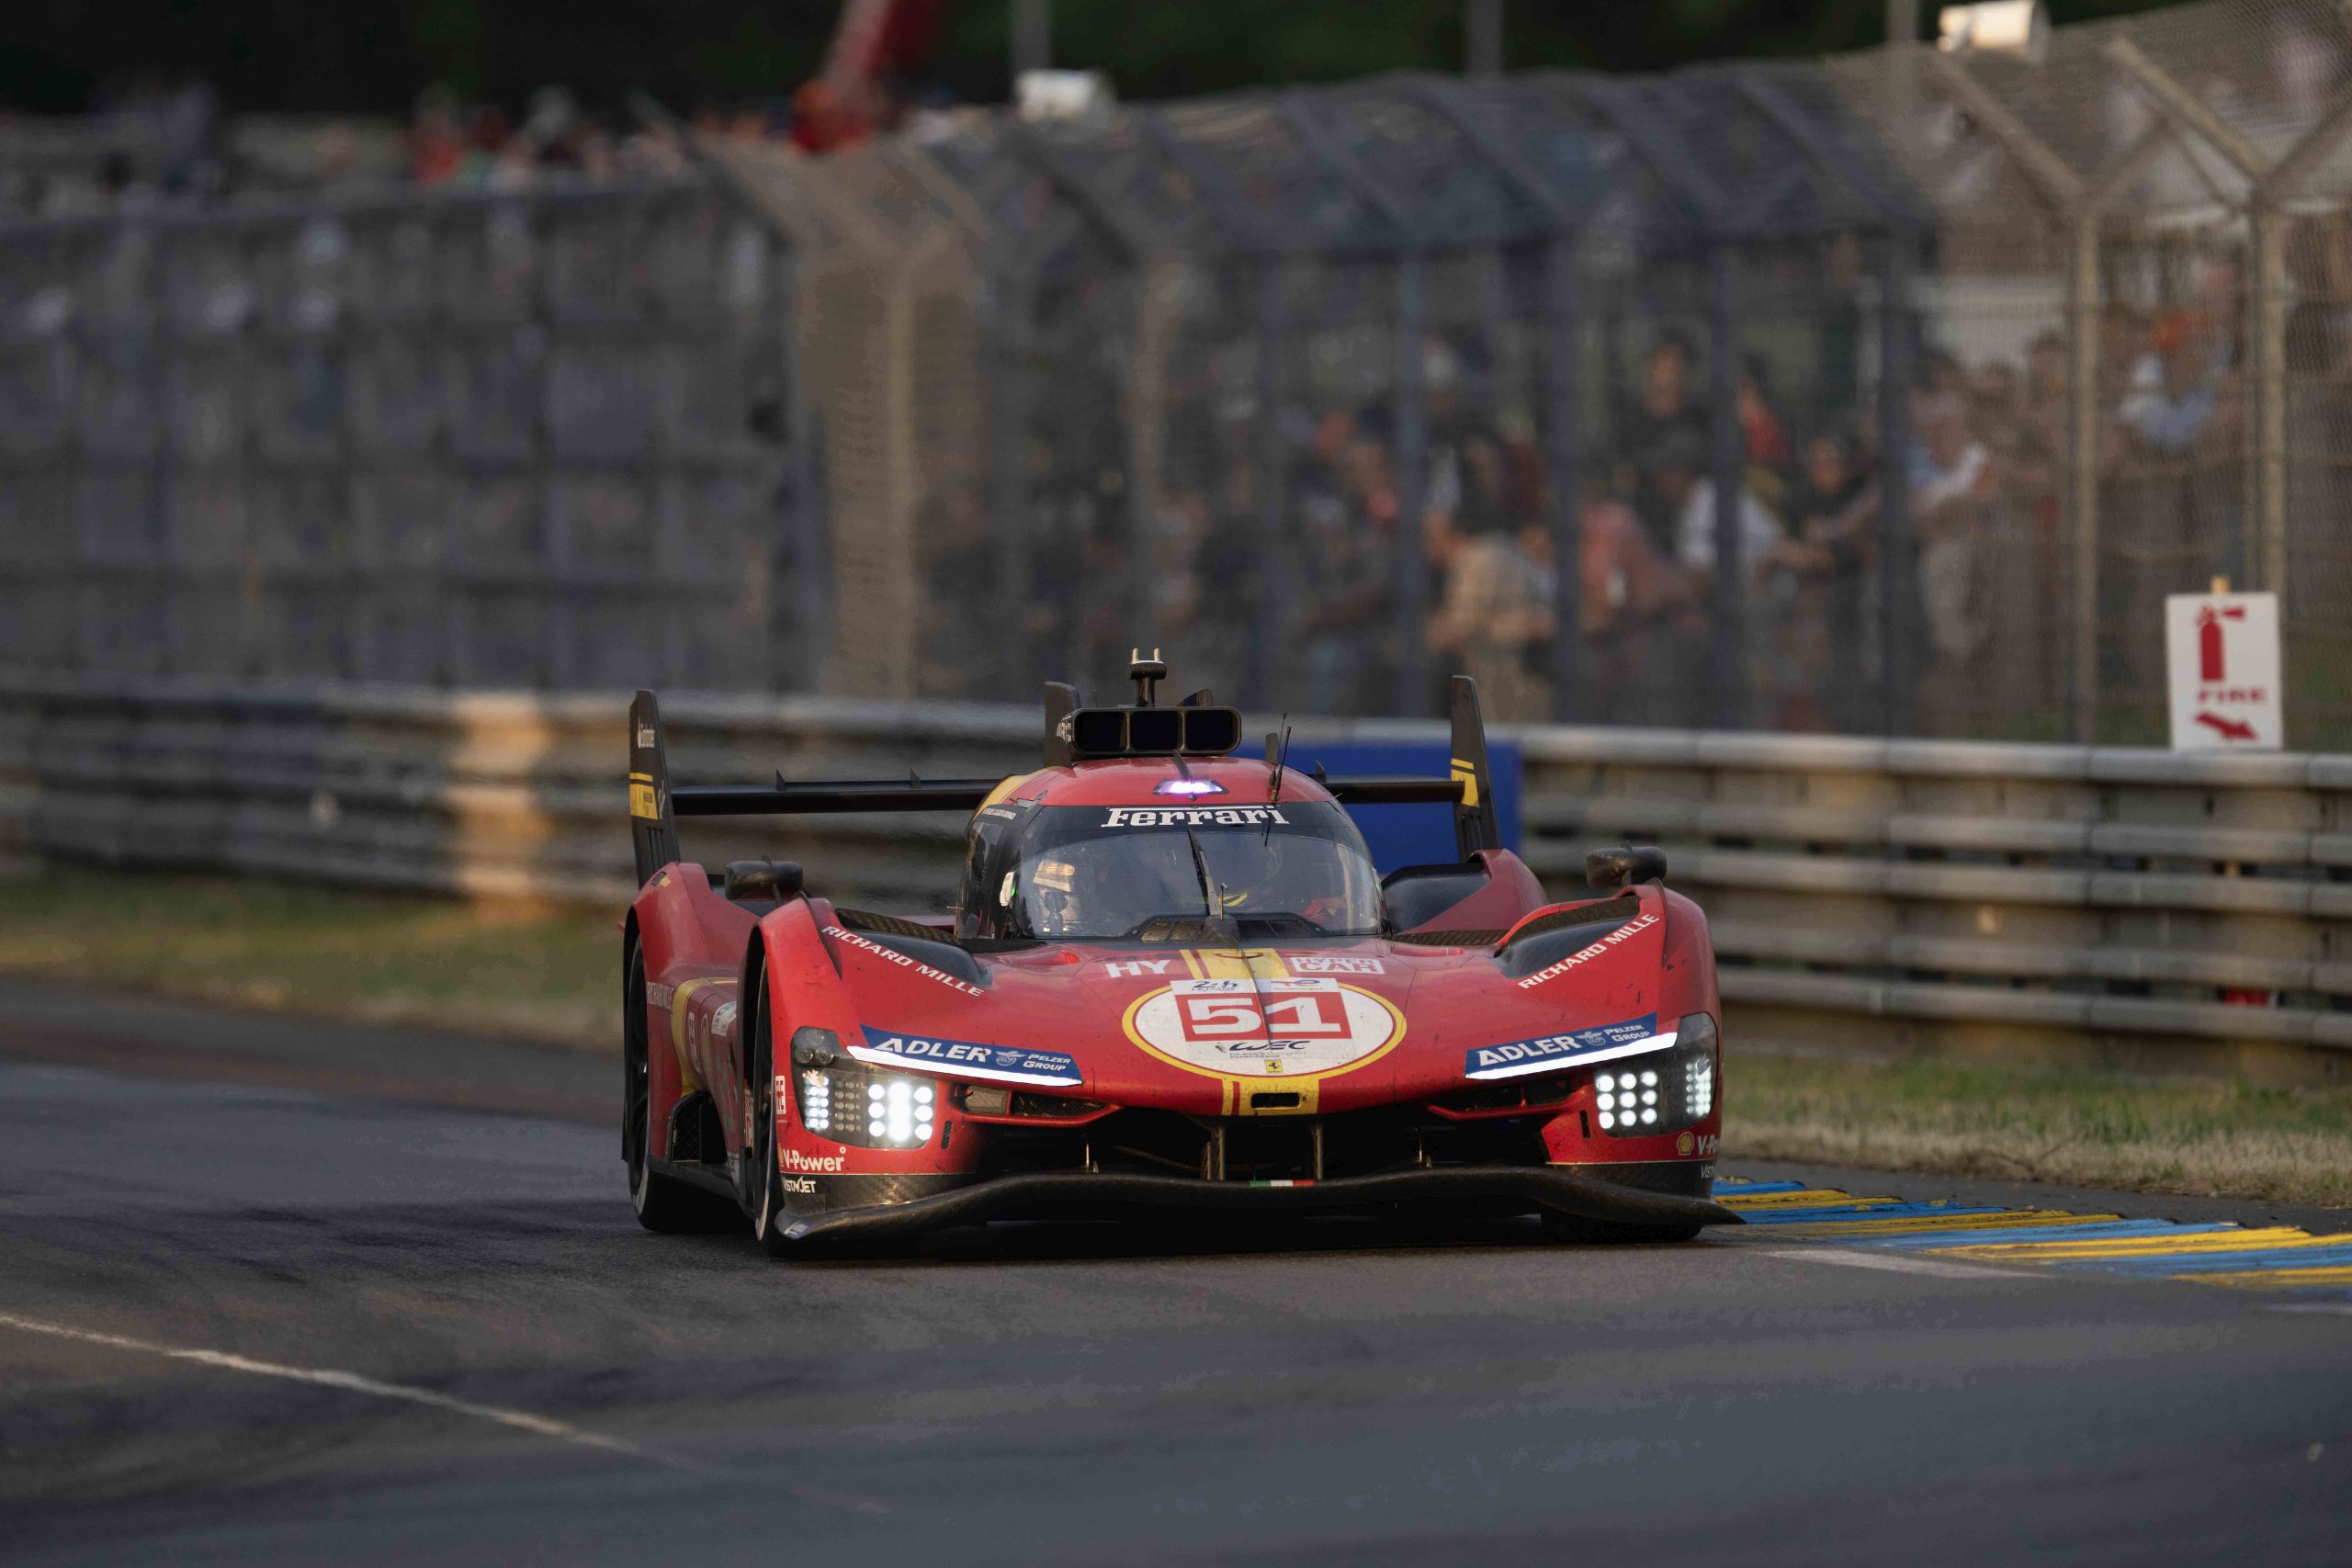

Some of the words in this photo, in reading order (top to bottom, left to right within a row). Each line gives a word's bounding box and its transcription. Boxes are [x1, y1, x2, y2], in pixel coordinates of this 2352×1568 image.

[2197, 689, 2267, 703] FIRE
[1102, 805, 1290, 828] Ferrari
[1517, 943, 1608, 989] RICHARD
[1604, 914, 1660, 945] MILLE
[821, 926, 914, 966] RICHARD
[915, 964, 985, 997] MILLE
[1104, 959, 1171, 978] HY
[1299, 963, 1378, 973] CAR
[1187, 997, 1341, 1035] 51
[1603, 1024, 1644, 1036] PELZER
[1612, 1032, 1650, 1043] GROUP
[874, 1037, 992, 1063] ADLER
[1229, 1040, 1311, 1052] WEC
[1477, 1035, 1582, 1066] ADLER
[1023, 1061, 1066, 1072] GROUP
[1027, 1054, 1071, 1065] PELZER
[783, 1148, 844, 1172] V-Power
